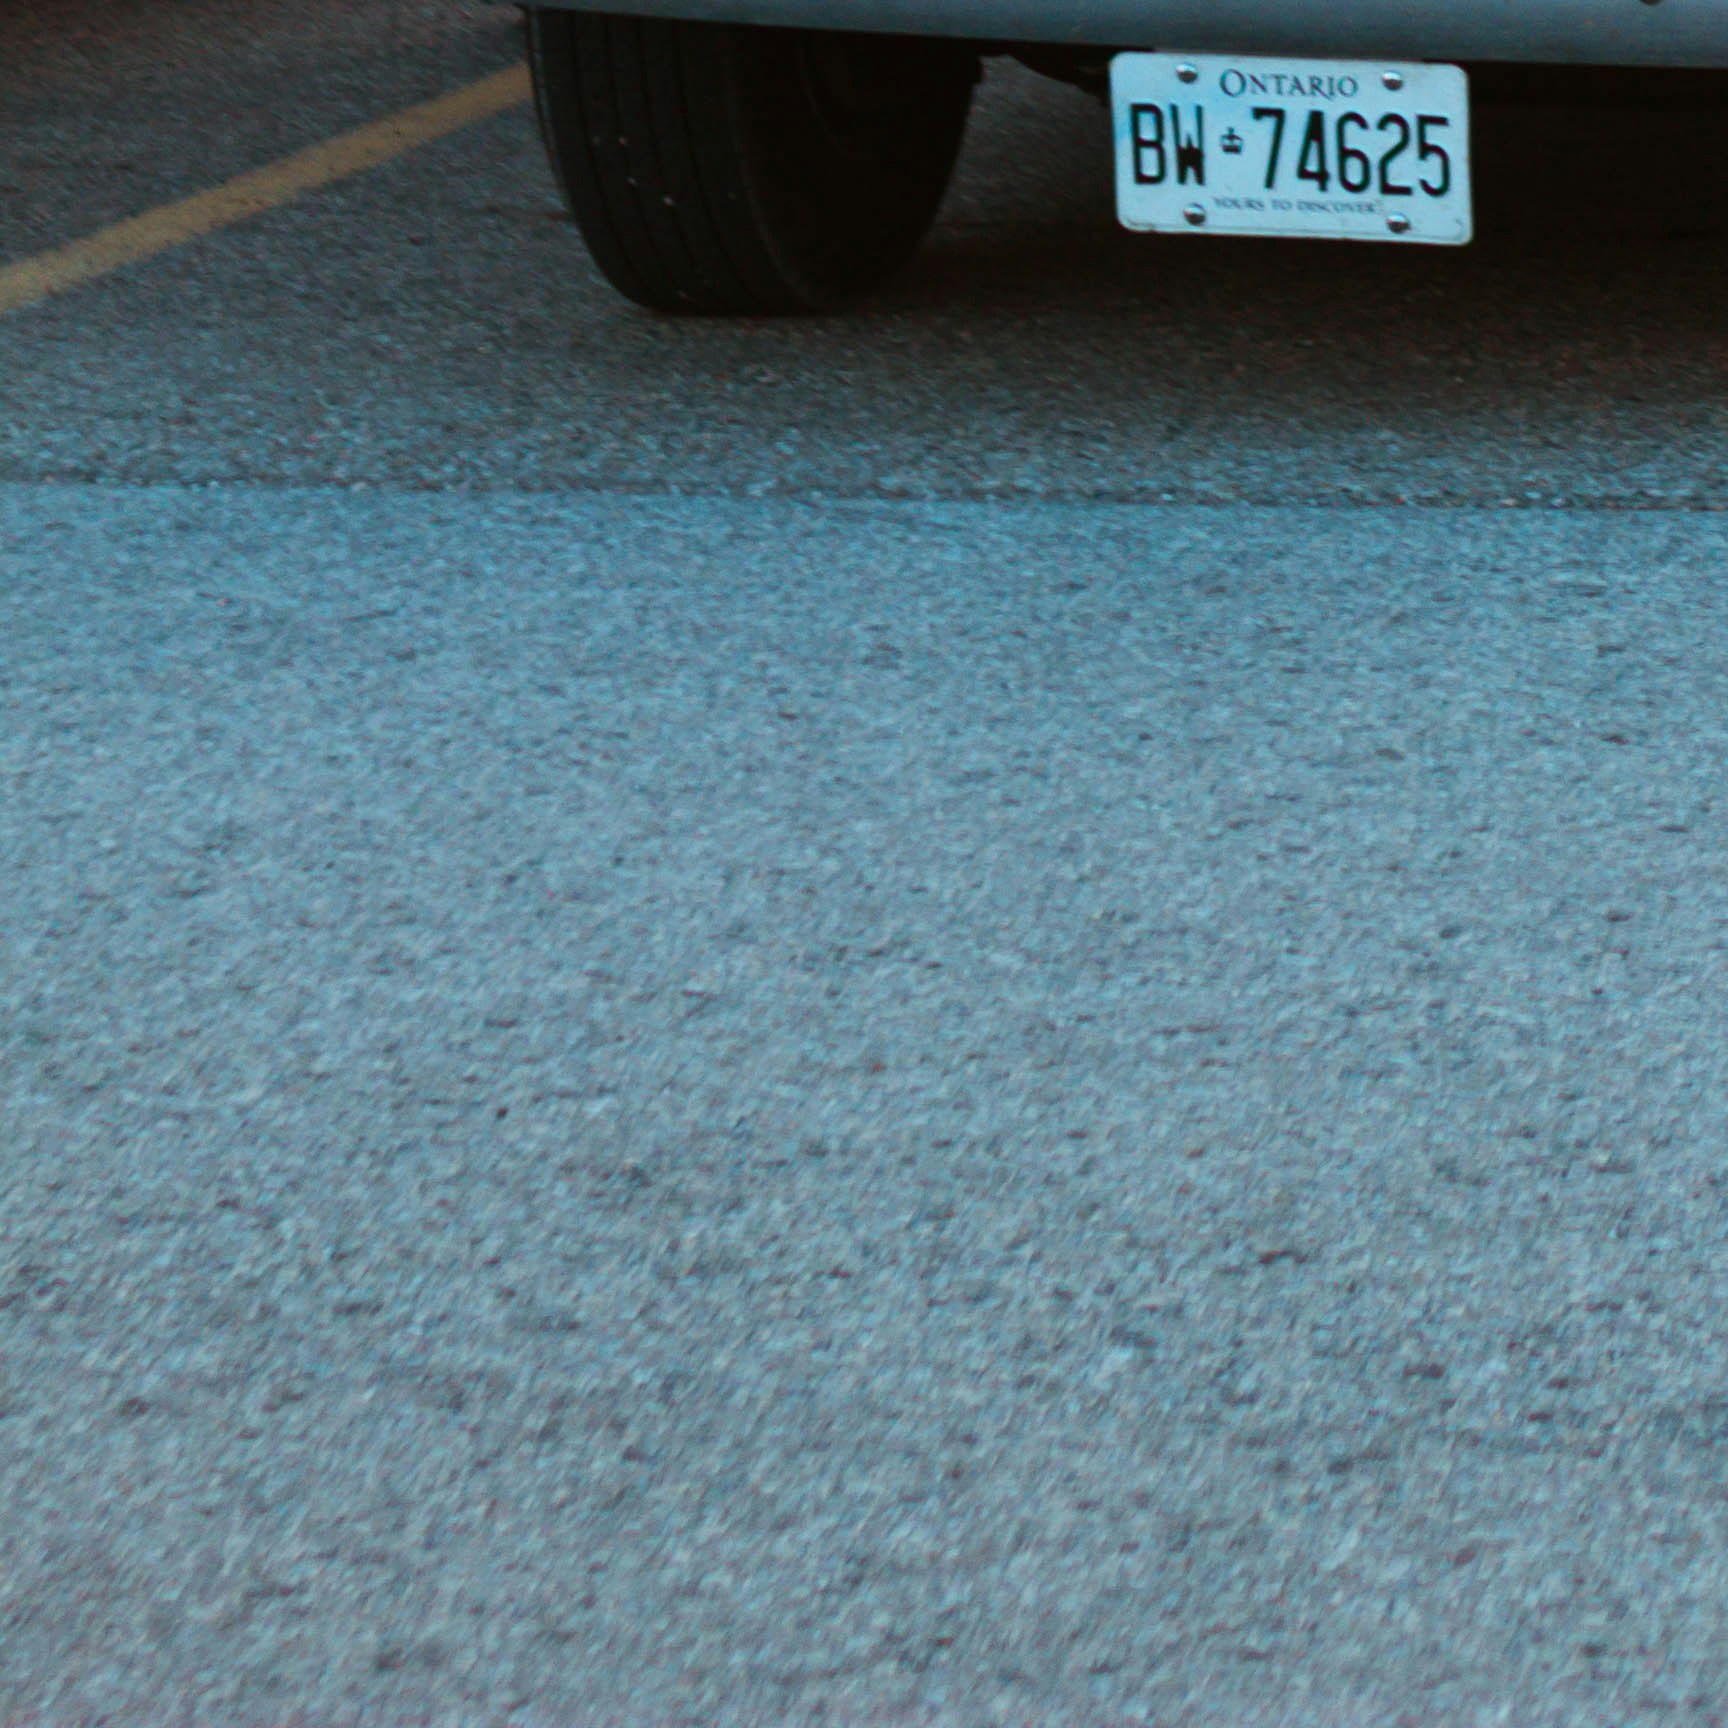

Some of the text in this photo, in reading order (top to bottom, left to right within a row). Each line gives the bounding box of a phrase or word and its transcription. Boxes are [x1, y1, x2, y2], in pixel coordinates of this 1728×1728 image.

[1219, 69, 1359, 101] ONTARIO
[1130, 102, 1451, 197] BW 74625
